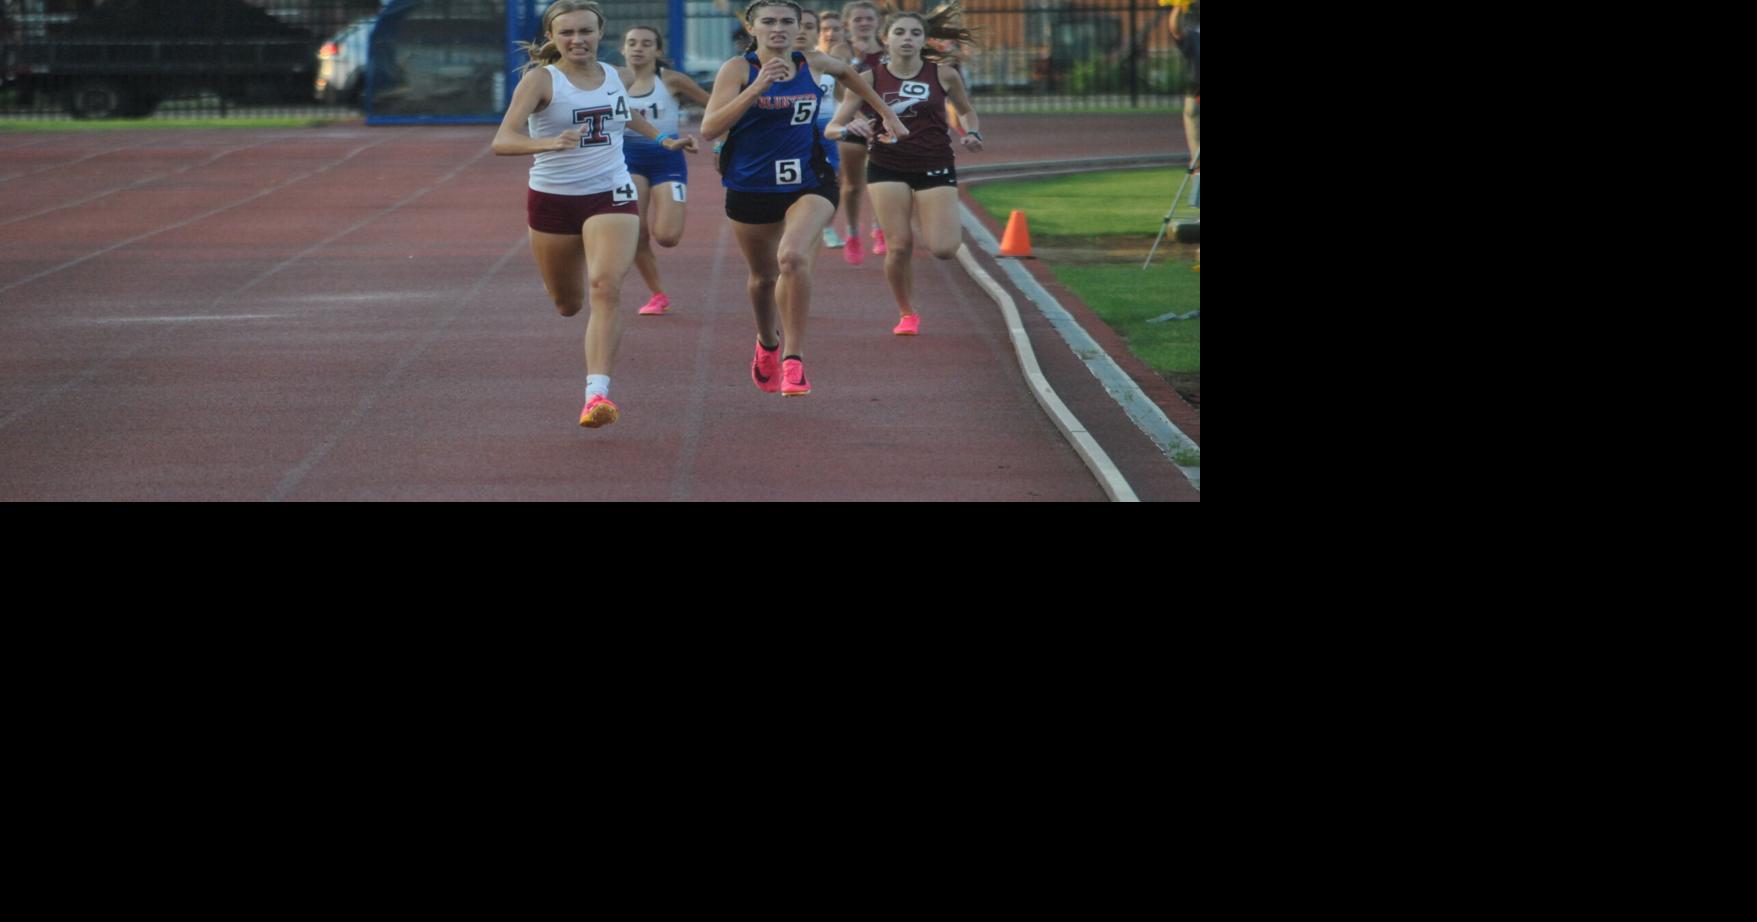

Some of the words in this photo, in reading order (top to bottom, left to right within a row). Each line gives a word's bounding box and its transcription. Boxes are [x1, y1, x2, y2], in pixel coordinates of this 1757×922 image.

[615, 96, 629, 119] 4
[648, 103, 659, 119] 1
[794, 102, 812, 123] 5
[573, 105, 614, 148] T
[779, 161, 798, 183] 5
[616, 183, 634, 198] 4
[674, 184, 684, 200] 1
